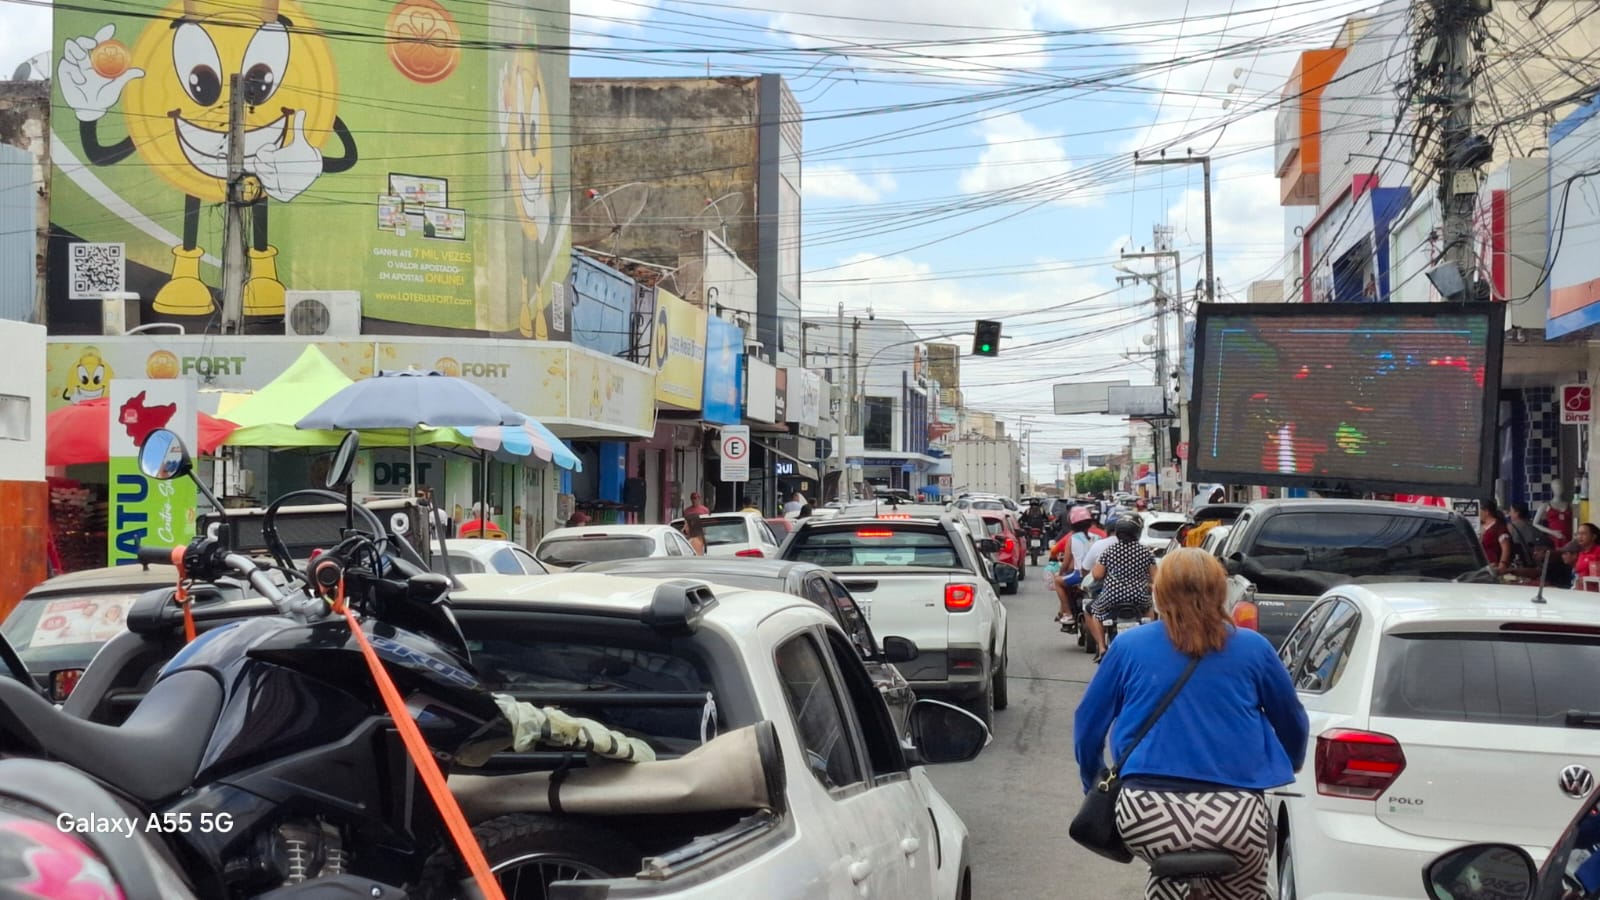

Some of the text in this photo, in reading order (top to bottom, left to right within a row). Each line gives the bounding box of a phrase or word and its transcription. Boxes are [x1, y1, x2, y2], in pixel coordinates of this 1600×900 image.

[373, 248, 398, 257] GANHE
[413, 248, 419, 258] 7
[421, 249, 439, 260] MIL
[441, 252, 472, 263] VEZES
[395, 262, 418, 270] VALOR
[420, 263, 459, 273] APOSTADO
[380, 272, 464, 286] EM APOSTAS ONLINE!
[182, 356, 246, 375] FORT
[462, 363, 511, 378] FORT
[731, 441, 740, 455] E
[1388, 796, 1424, 805] POLO
